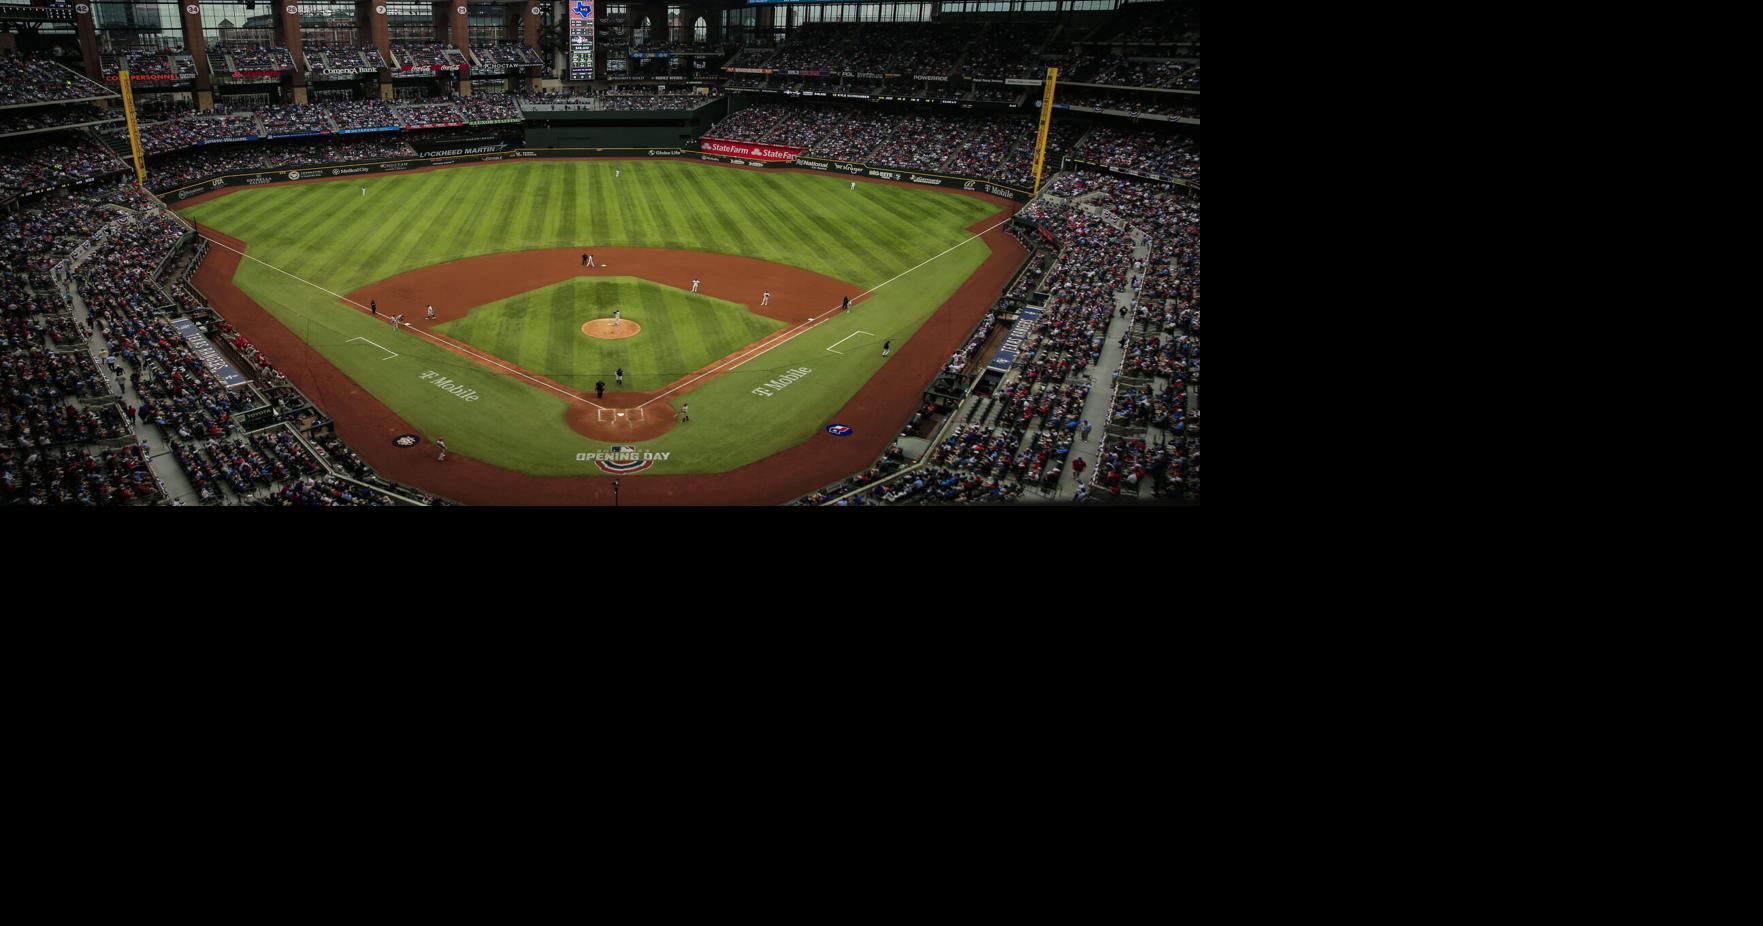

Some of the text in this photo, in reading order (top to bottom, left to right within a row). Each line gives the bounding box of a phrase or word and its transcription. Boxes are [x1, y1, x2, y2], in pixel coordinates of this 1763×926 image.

[419, 146, 496, 158] LOCKHEED MARTIN
[762, 149, 797, 160] StateFar
[575, 452, 671, 461] OPENING DAY
